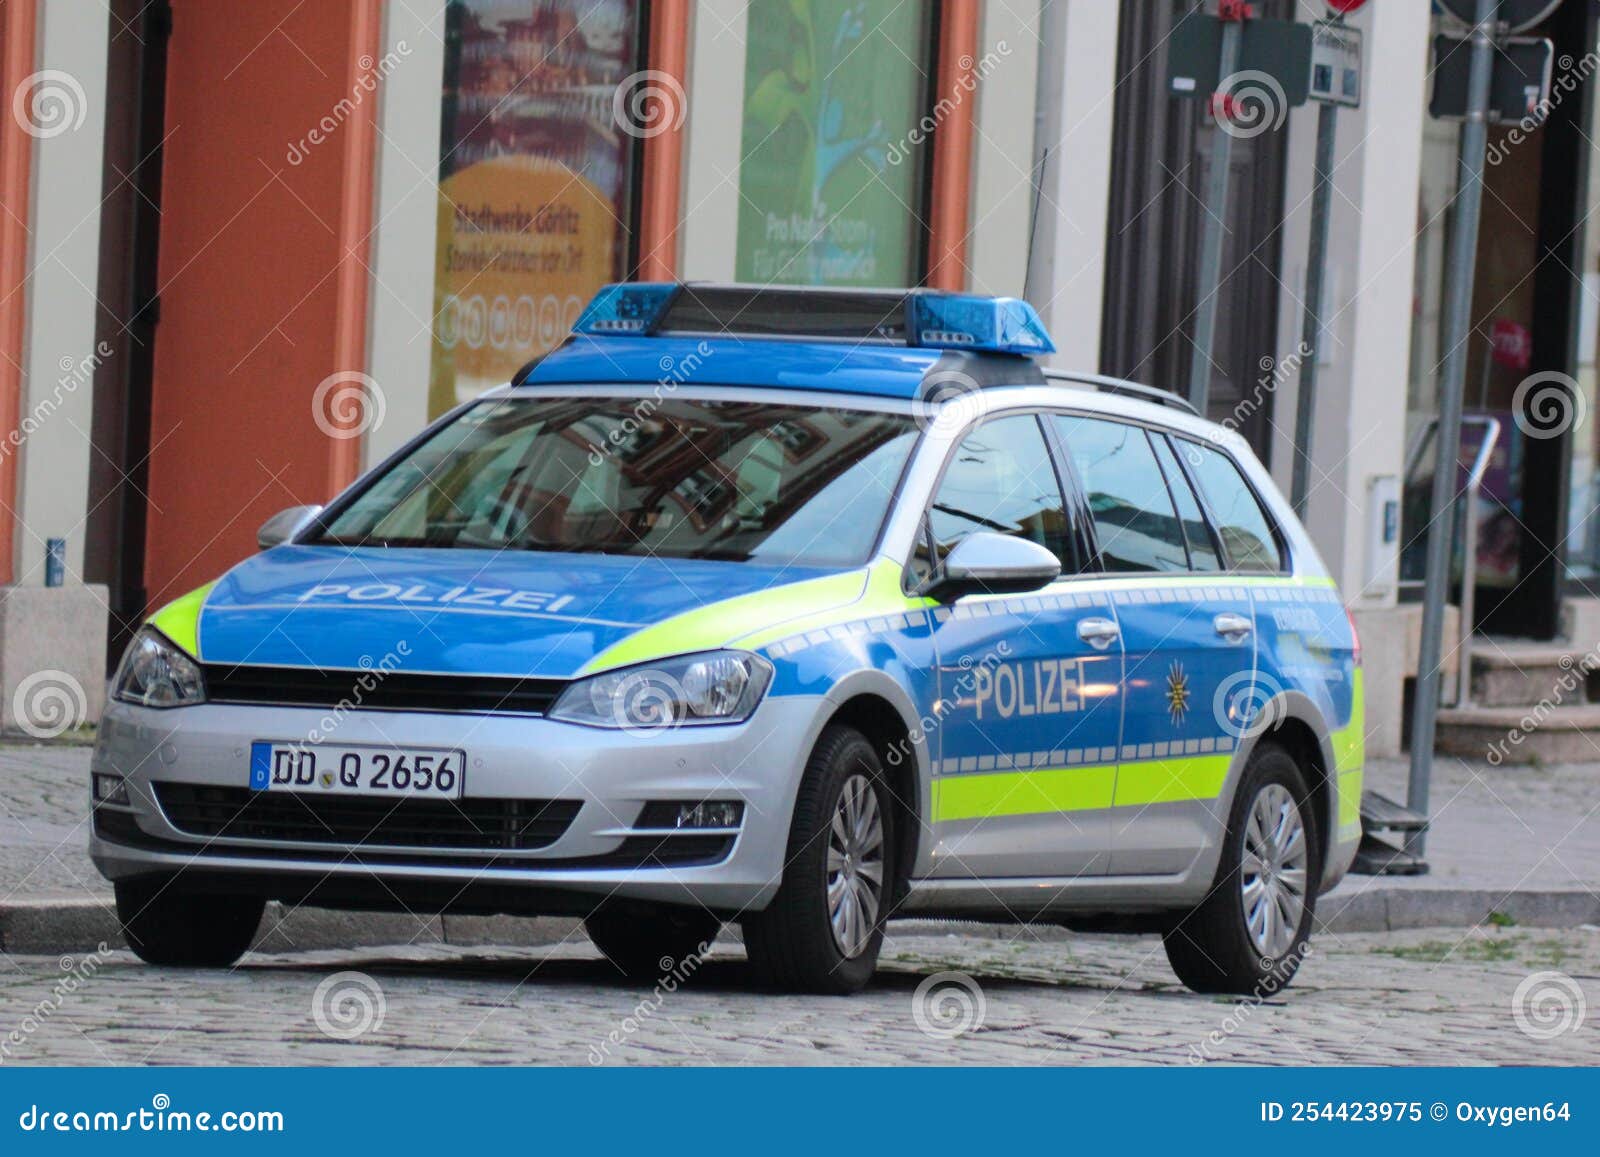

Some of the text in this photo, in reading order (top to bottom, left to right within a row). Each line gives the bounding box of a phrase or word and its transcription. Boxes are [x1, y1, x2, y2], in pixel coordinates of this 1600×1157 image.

[298, 583, 576, 613] POLIZEI
[975, 660, 1086, 720] POLIZEI
[273, 750, 455, 792] DD Q 2656
